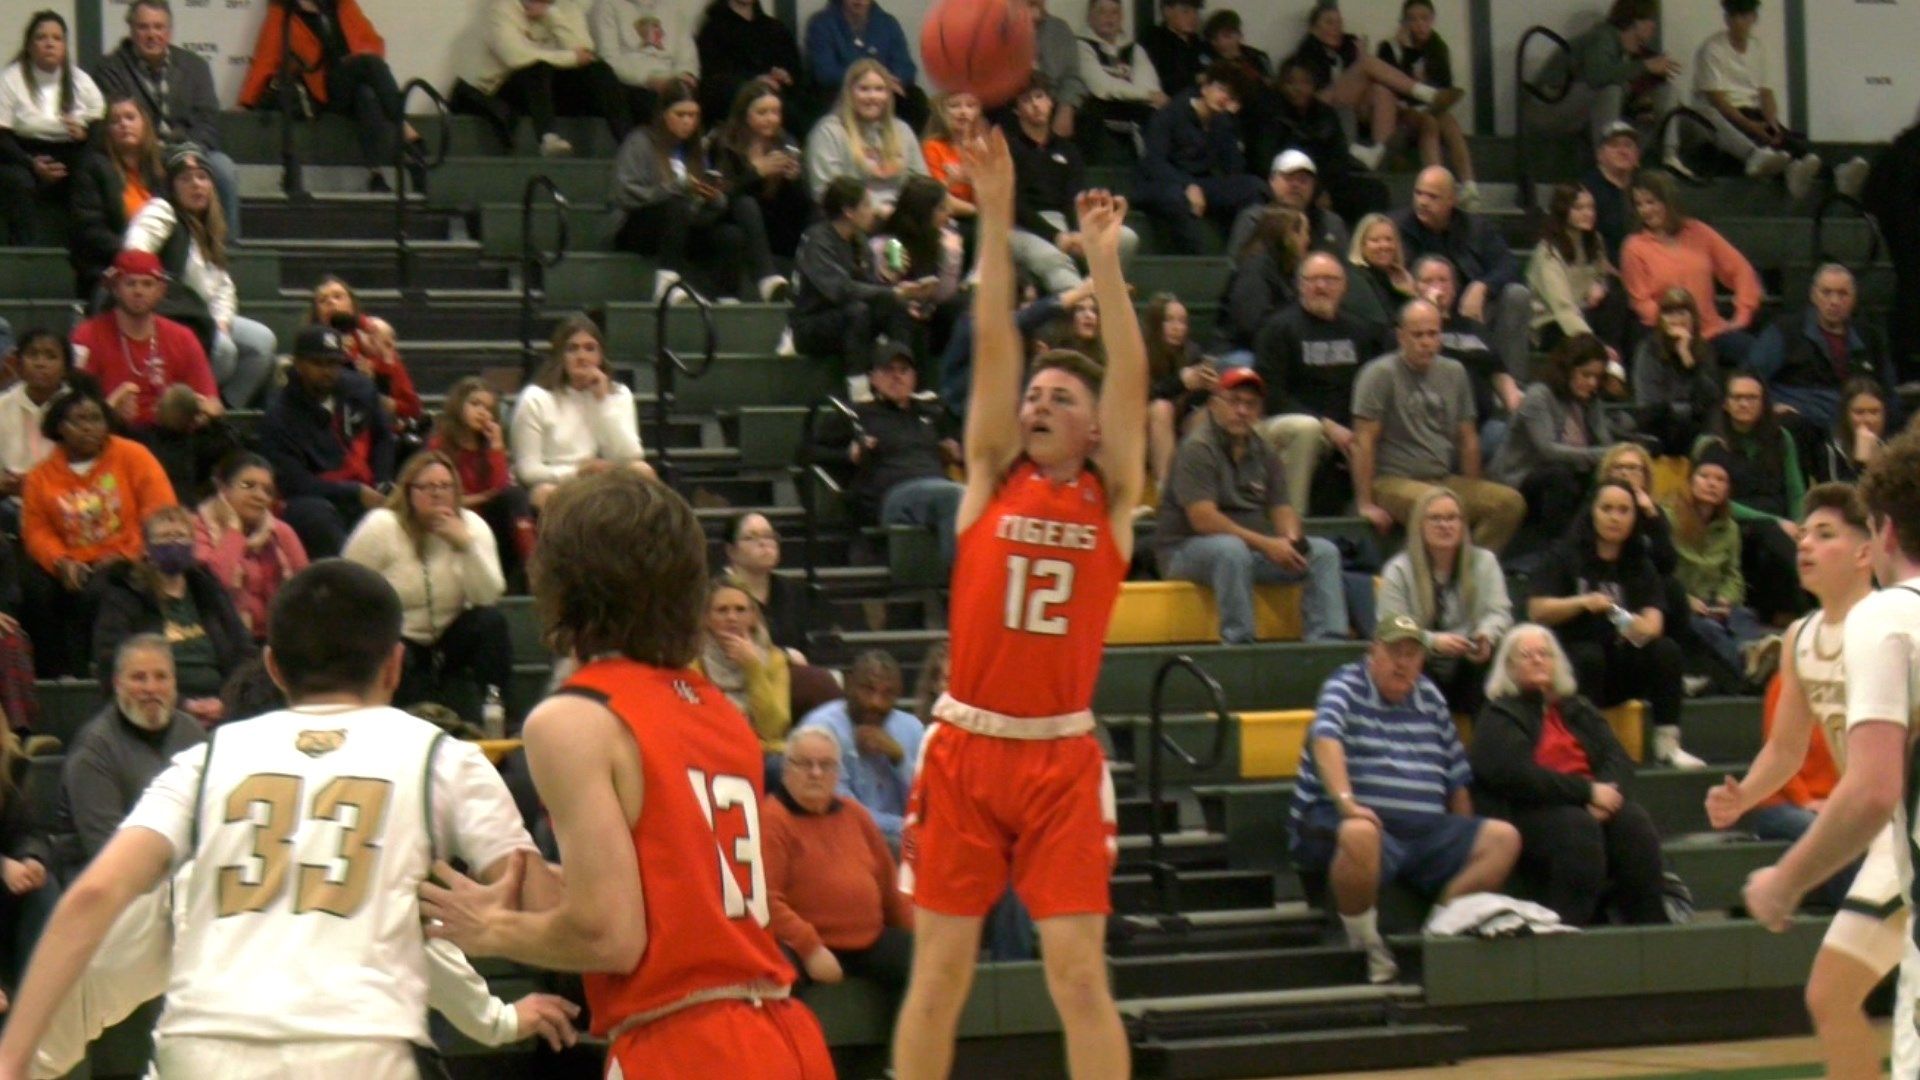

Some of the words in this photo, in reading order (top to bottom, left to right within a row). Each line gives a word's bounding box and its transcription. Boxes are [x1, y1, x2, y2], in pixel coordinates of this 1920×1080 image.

[995, 514, 1099, 551] TIGERS
[1004, 553, 1076, 636] 12
[216, 772, 395, 920] 33
[686, 766, 771, 930] 13
